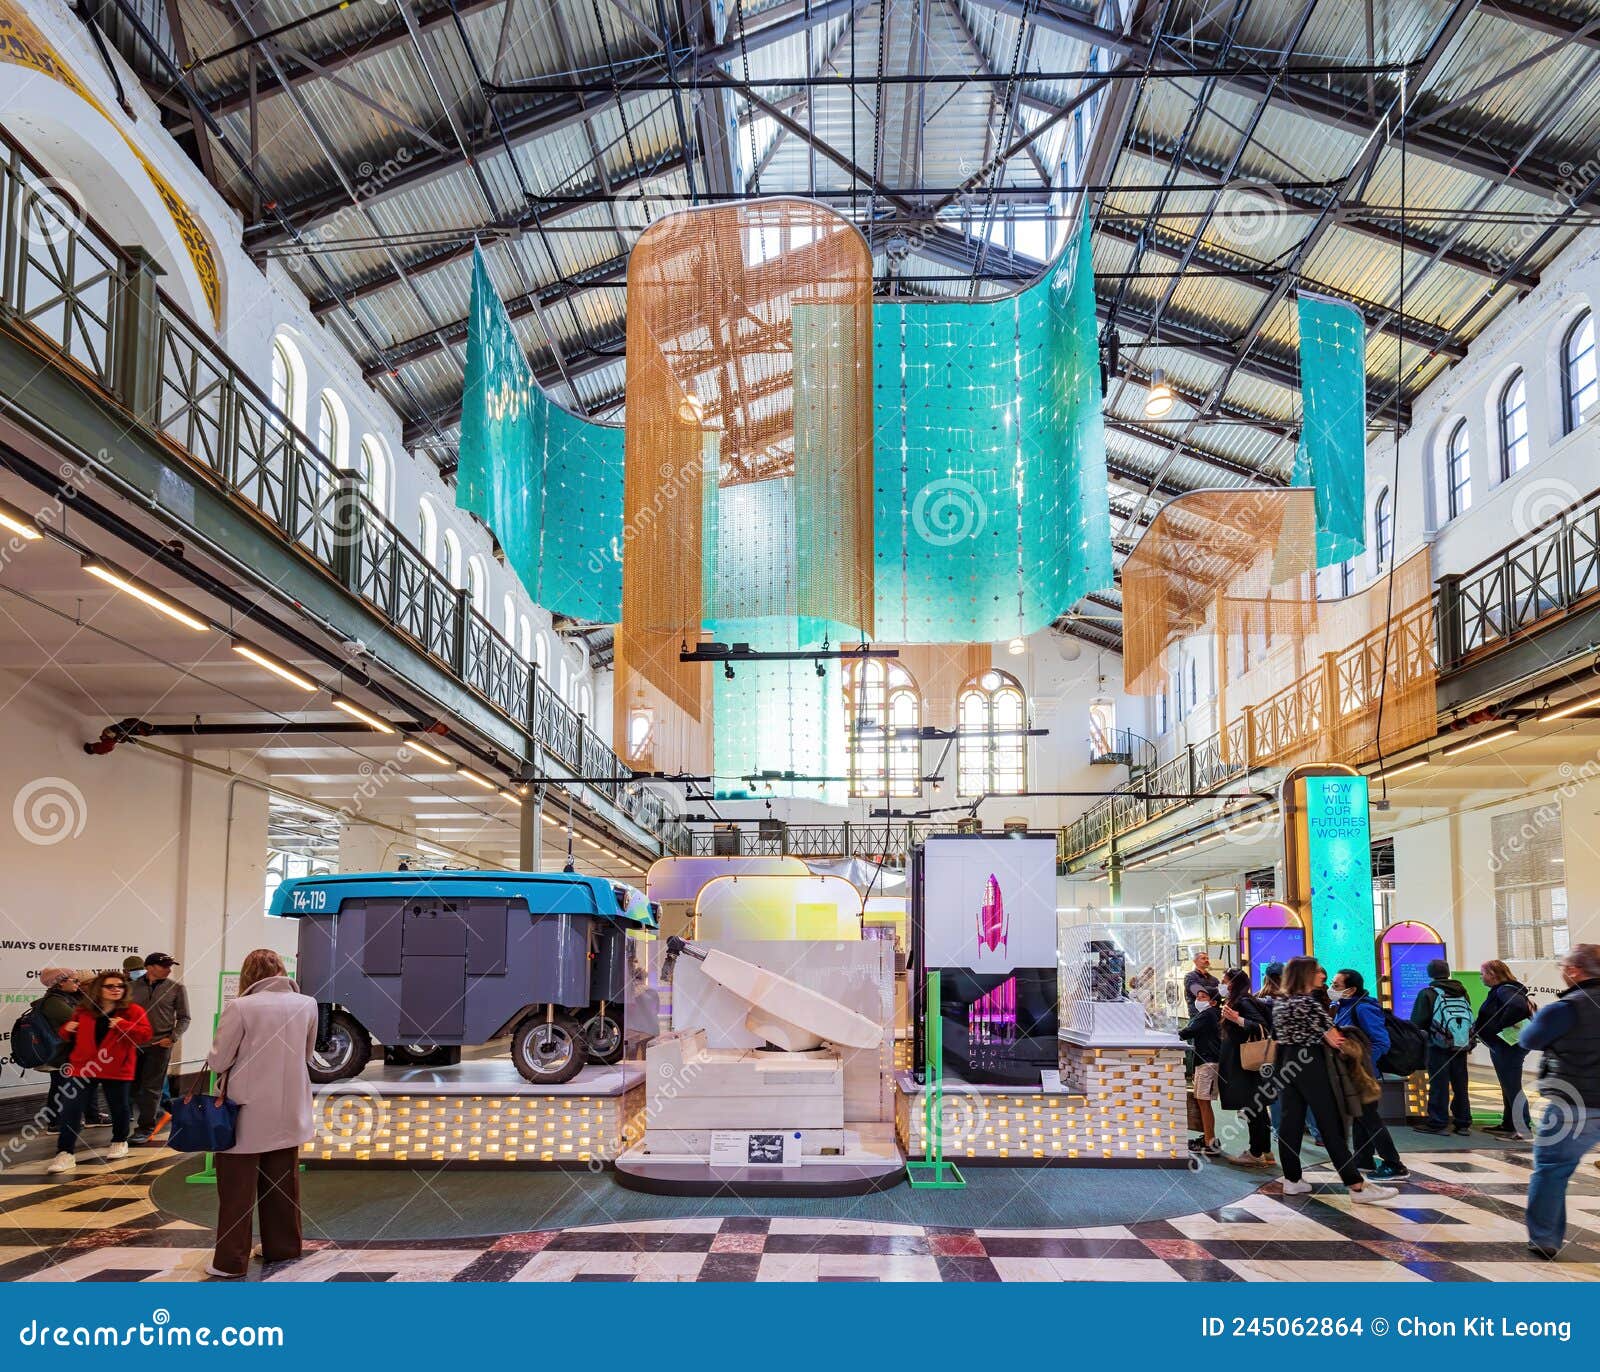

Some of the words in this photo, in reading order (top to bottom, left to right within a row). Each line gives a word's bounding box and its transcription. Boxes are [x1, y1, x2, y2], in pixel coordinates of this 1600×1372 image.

[1322, 783, 1352, 793] HOW
[1324, 795, 1352, 805] WILL
[1324, 806, 1351, 816] OUR
[1311, 817, 1367, 827] FUTURES
[1317, 828, 1361, 839] WORK?
[292, 890, 327, 910] T4-119
[39, 942, 119, 953] OVERESTIMATE
[121, 945, 140, 954] THE
